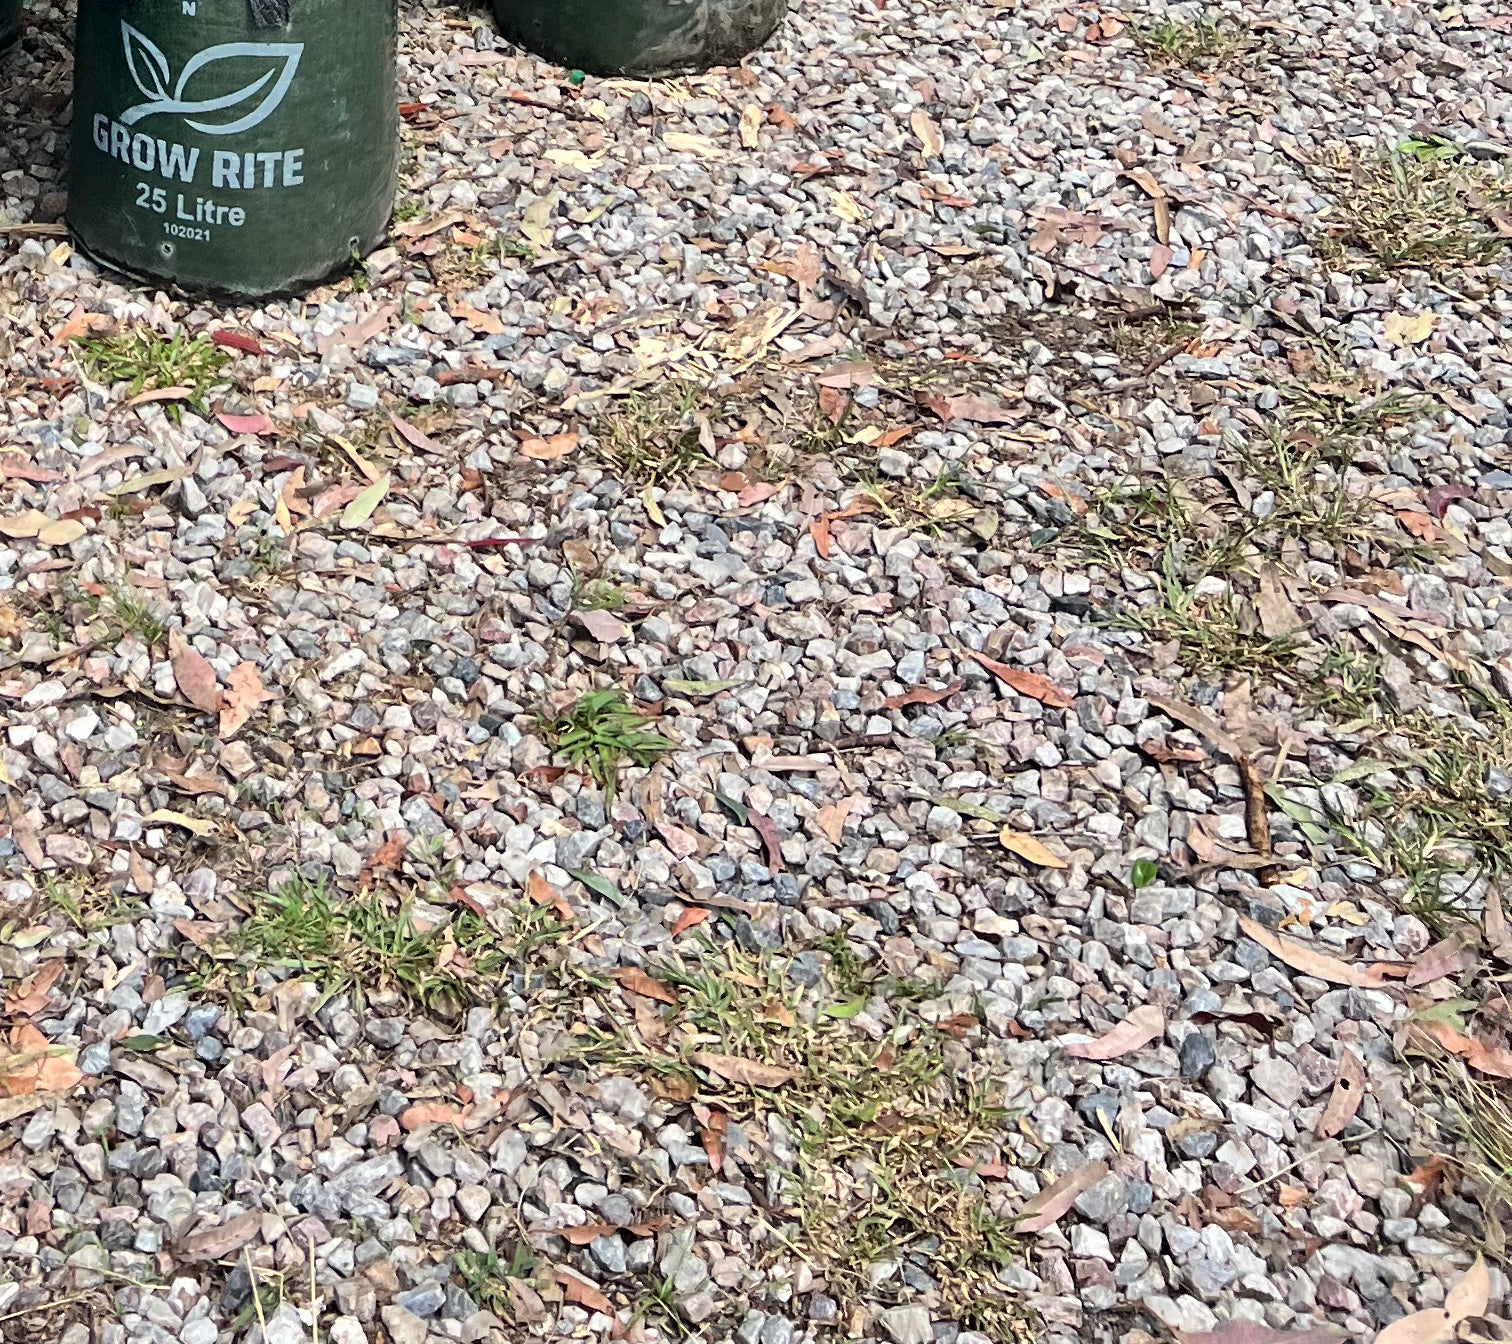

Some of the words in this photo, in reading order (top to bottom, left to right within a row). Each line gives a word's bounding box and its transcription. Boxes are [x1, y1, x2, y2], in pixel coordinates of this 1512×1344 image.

[92, 113, 200, 183] GROW
[211, 148, 304, 189] RITE
[135, 182, 167, 214] 25
[176, 194, 245, 227] Litre
[163, 222, 211, 242] 102021
